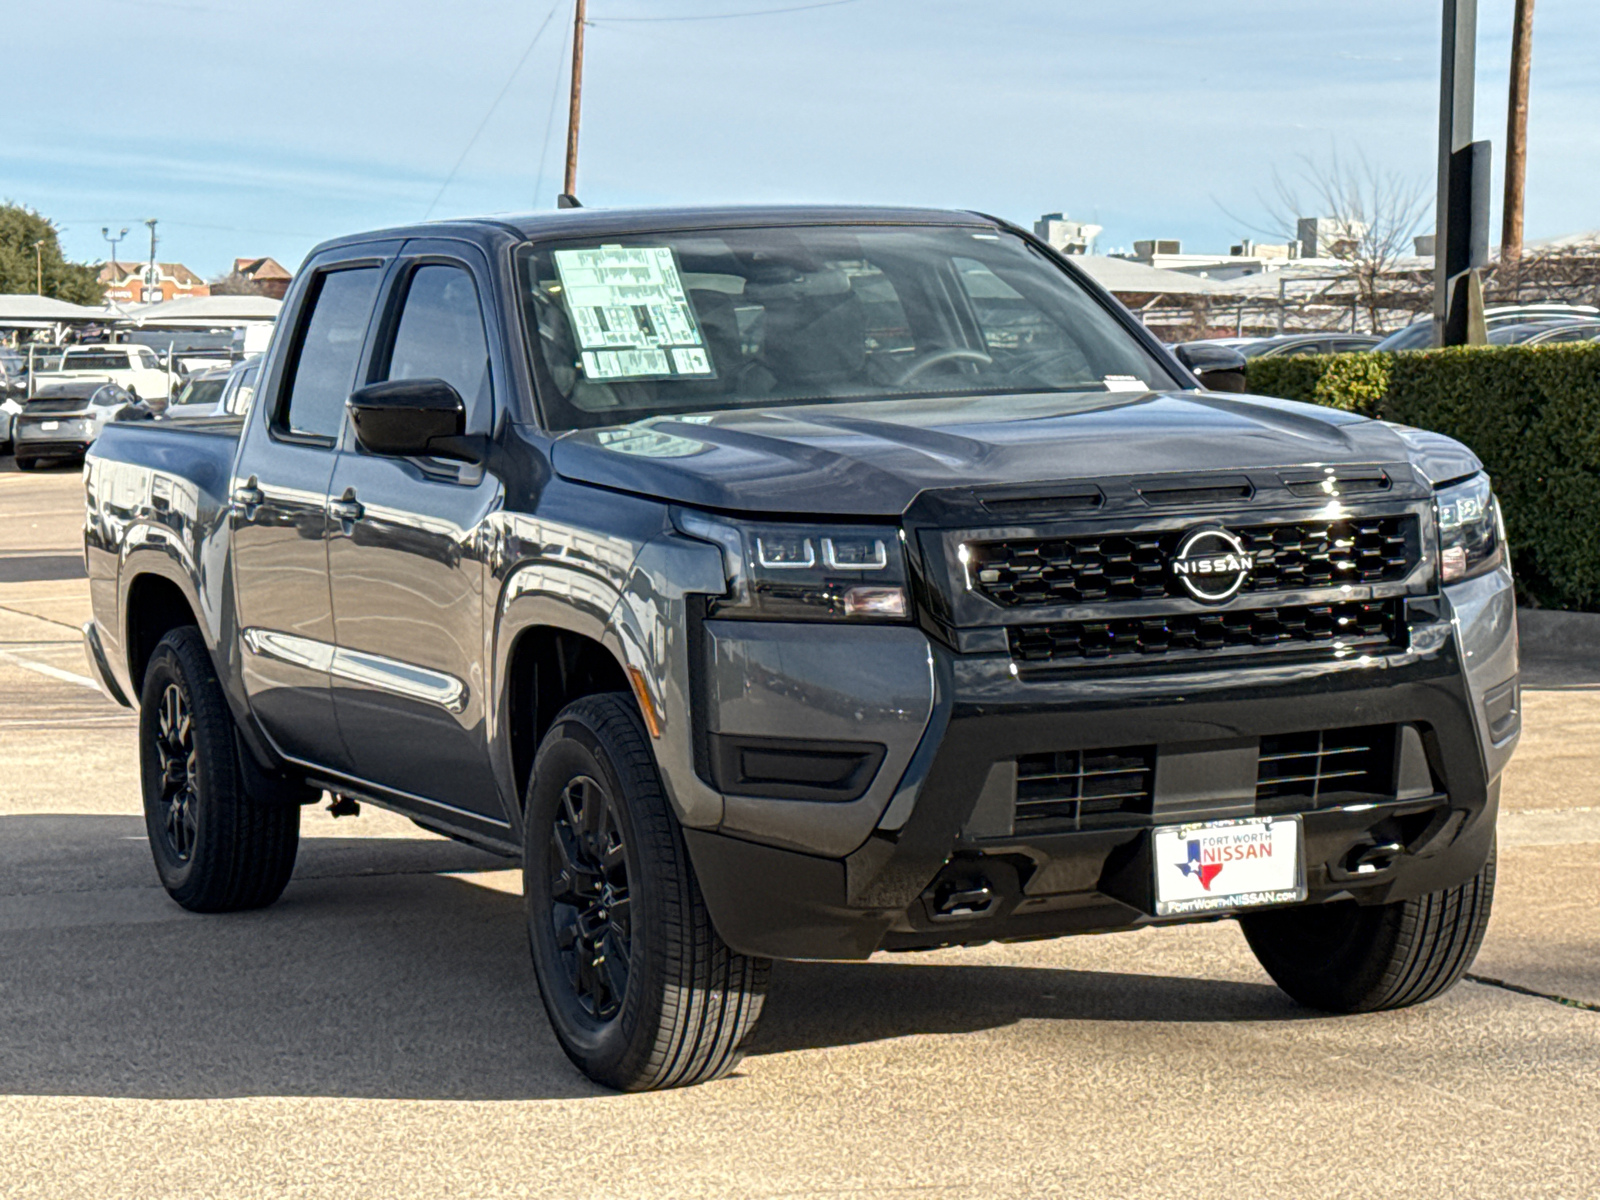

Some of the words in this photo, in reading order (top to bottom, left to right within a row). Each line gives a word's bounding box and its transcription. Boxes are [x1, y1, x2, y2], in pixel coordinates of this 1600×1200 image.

[1174, 557, 1253, 574] NISSAN
[1202, 836, 1229, 846] FORT
[1233, 832, 1273, 844] WORTH
[1203, 842, 1273, 863] NISSAN
